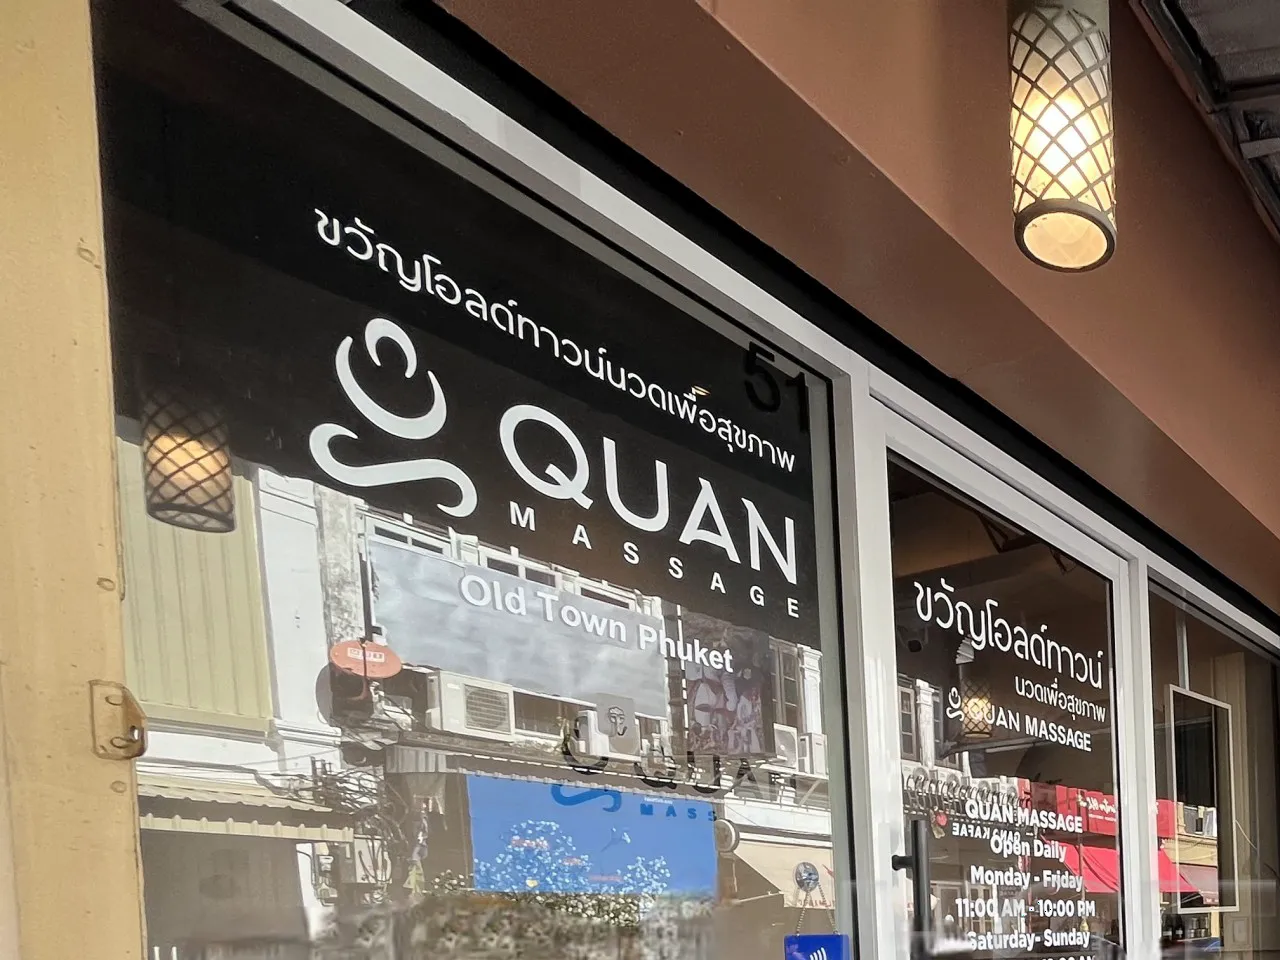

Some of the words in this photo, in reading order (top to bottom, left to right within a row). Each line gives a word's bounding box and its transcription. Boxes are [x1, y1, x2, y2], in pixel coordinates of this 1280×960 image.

[315, 208, 795, 472] ขวัญโอลด์ทาวน์นวดเพื่อสุขภาพ
[499, 404, 798, 585] QUAN
[509, 501, 800, 618] MASSAGE
[459, 574, 527, 616] Old
[536, 589, 628, 643] Town
[638, 623, 734, 673] Phuket
[914, 577, 1104, 690] ขวัญโอลด์ทาวน์
[1015, 676, 1106, 723] นวดเพื่อสุขภาพ
[1025, 714, 1092, 752] MASSAGE
[965, 800, 1013, 824] QUAN
[1017, 807, 1083, 834] MASSAGE
[990, 835, 1030, 858] Open
[1034, 839, 1067, 863] Daily
[970, 865, 1031, 888] Monday
[1043, 870, 1083, 893] Friday
[955, 898, 998, 918] 11:00
[1001, 899, 1027, 918] AM
[1038, 899, 1074, 917] 10:00
[1077, 900, 1095, 917] PM
[1043, 928, 1090, 948] Sunday
